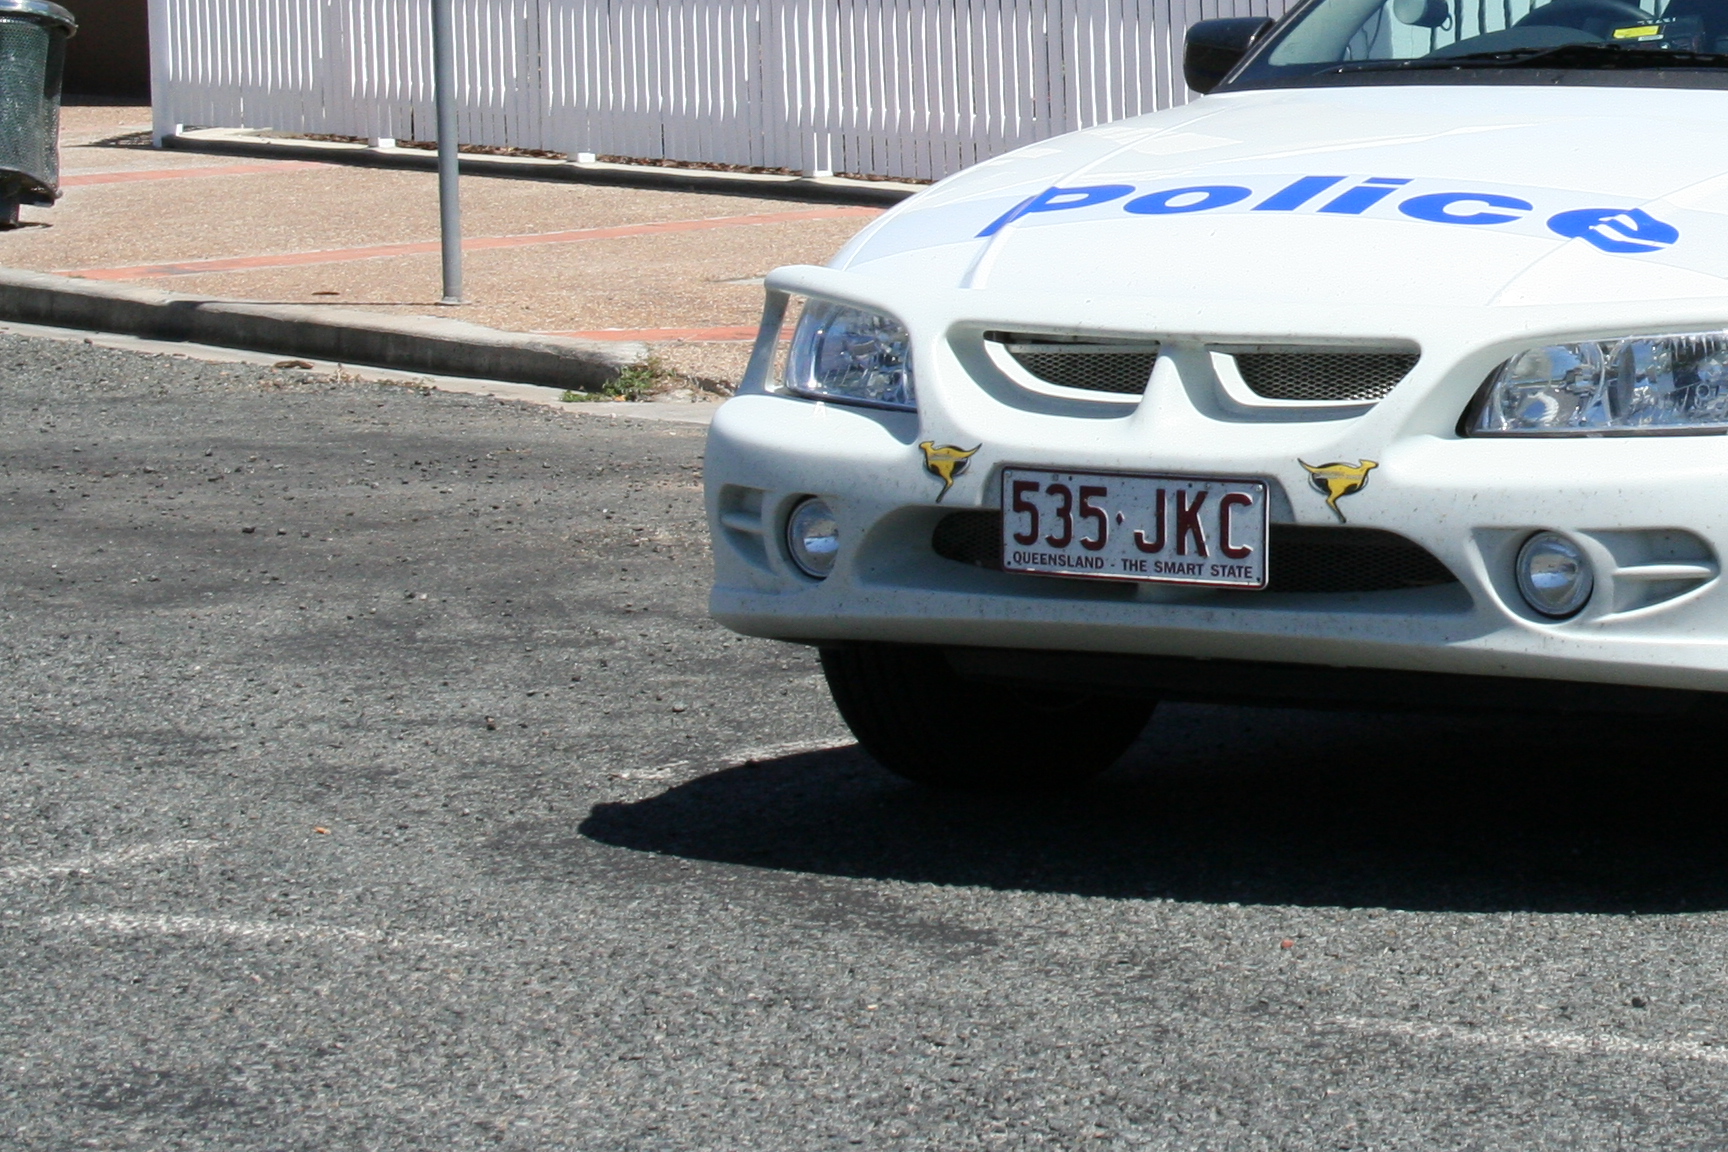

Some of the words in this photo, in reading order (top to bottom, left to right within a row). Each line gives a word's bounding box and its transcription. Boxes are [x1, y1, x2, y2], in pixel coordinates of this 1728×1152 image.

[975, 175, 1679, 253] police
[1012, 480, 1108, 551] 535
[1133, 488, 1254, 559] JKC
[1013, 551, 1105, 570] QUEENSLAND
[1121, 558, 1148, 573] THE
[1153, 561, 1204, 576] SMART
[1210, 564, 1254, 579] STATE
